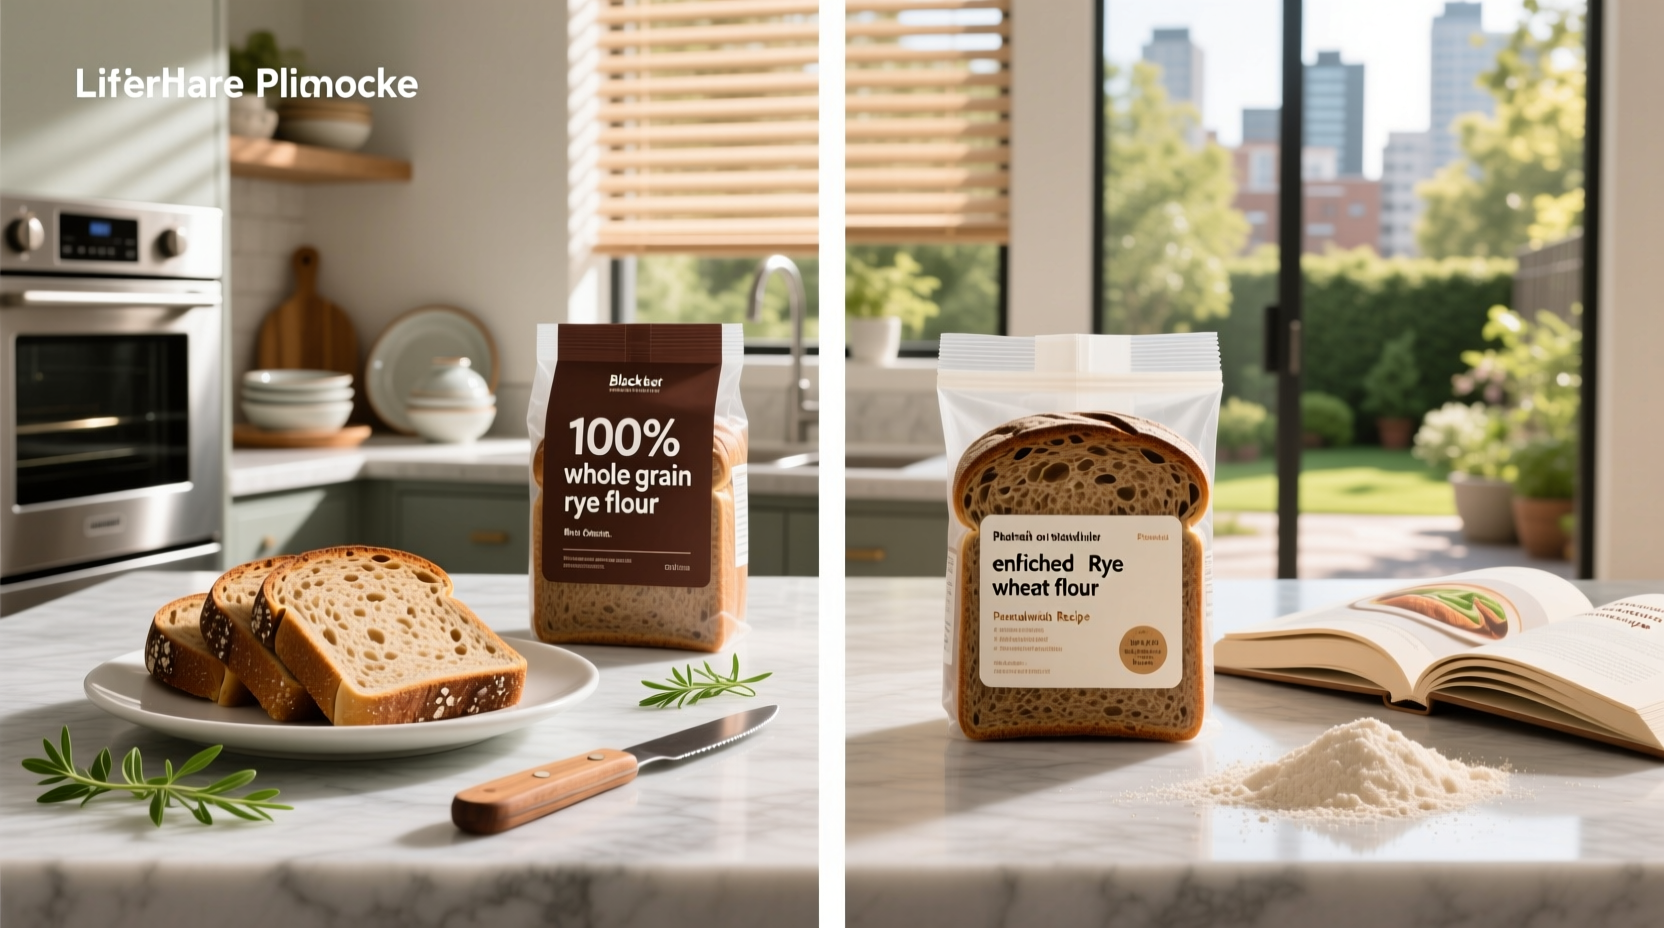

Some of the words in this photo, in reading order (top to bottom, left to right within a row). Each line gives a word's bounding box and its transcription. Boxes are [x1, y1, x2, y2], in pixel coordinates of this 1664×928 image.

[569, 416, 681, 457] 100%
[564, 462, 631, 485] whole
[635, 463, 692, 493] grain
[564, 495, 600, 520] rye
[604, 489, 660, 514] flour
[1089, 554, 1124, 578] Rye
[992, 578, 1050, 597] wheat
[1054, 577, 1099, 597] flour
[1056, 610, 1091, 625] Recipe
